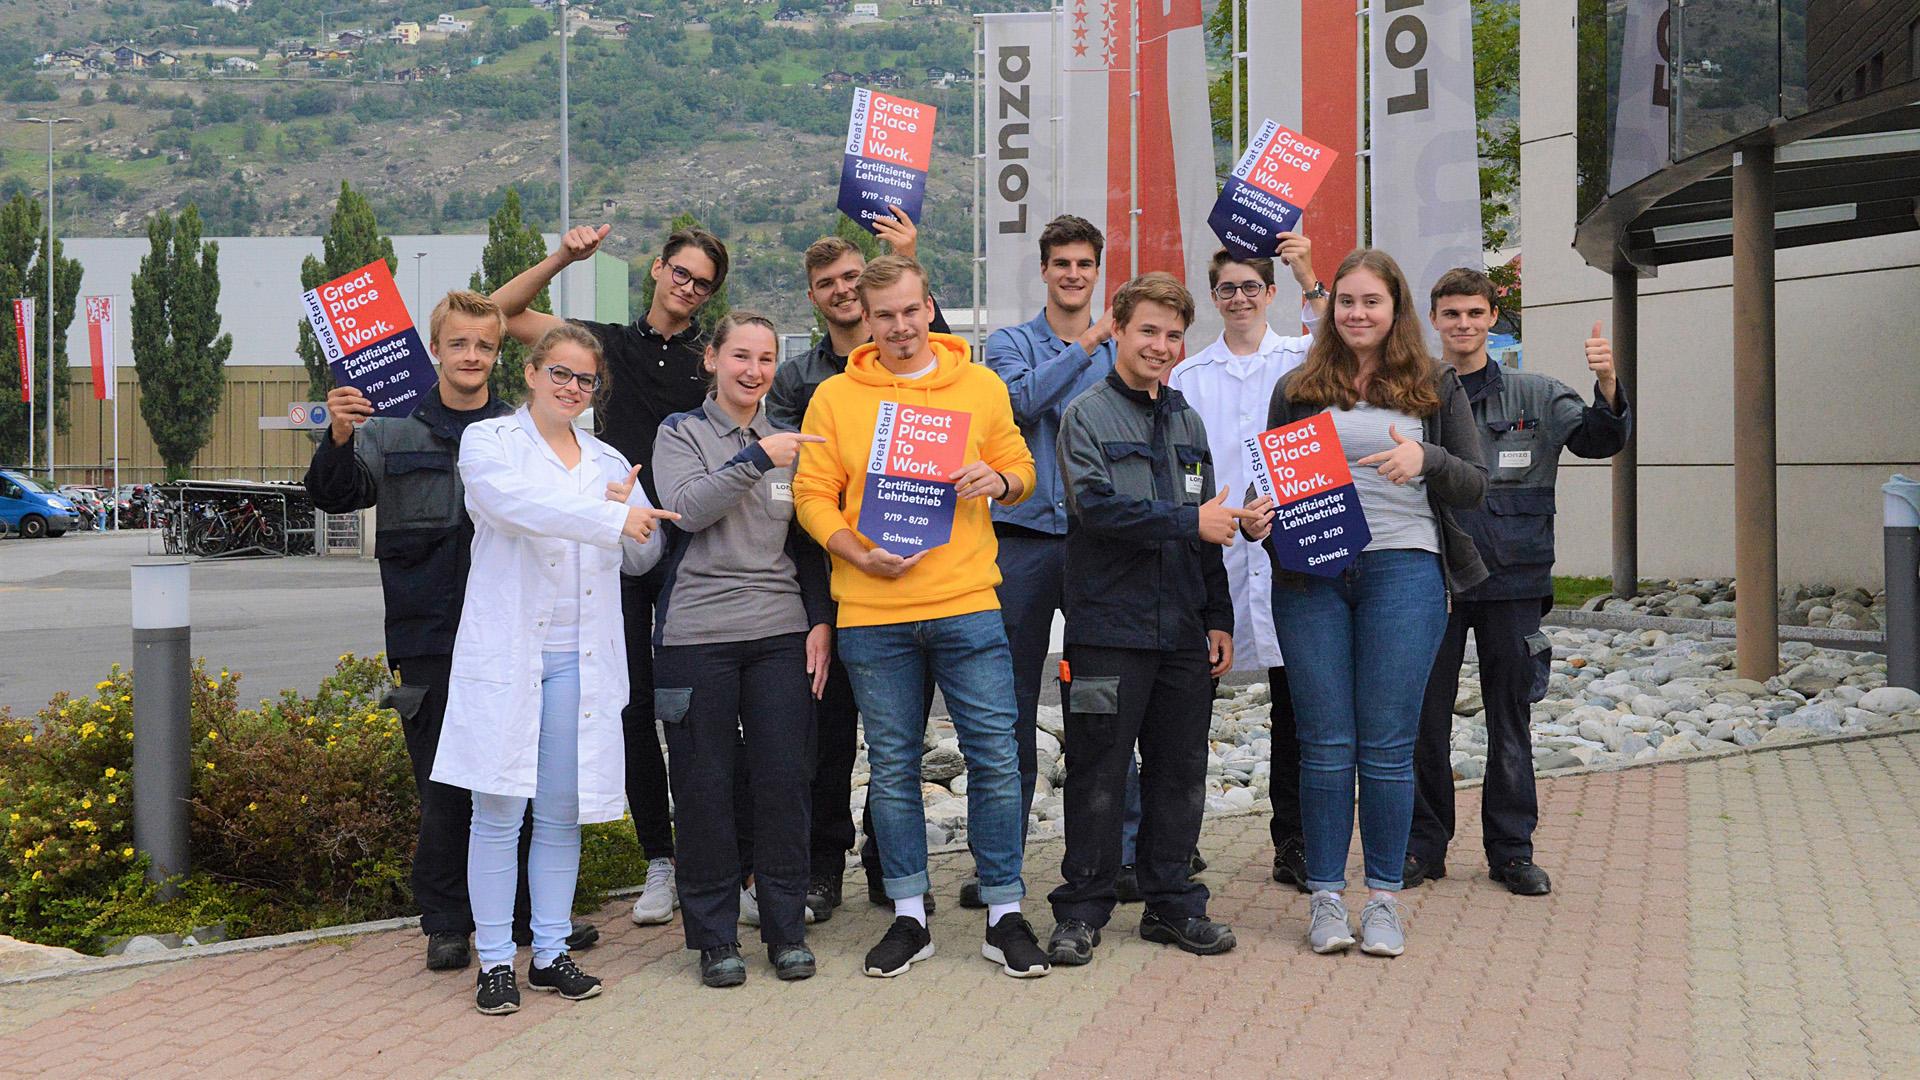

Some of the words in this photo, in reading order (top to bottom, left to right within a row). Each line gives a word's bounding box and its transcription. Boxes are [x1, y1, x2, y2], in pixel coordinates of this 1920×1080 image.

[855, 90, 868, 120] Start!
[874, 97, 920, 119] Great
[870, 126, 887, 140] To
[872, 112, 917, 132] Place
[850, 122, 862, 152] Great
[998, 46, 1030, 234] Lonza
[1237, 150, 1258, 176] Great
[1255, 121, 1276, 148] Start!
[1277, 132, 1320, 160] Great
[855, 160, 916, 180] Zertifizierter
[1263, 156, 1278, 172] To
[1270, 144, 1311, 172] Place
[856, 170, 912, 190] Lehrbetrieb
[862, 191, 878, 201] 9/19
[884, 195, 902, 205] 8/20
[1232, 192, 1283, 223] Lehrbetrieb
[1236, 183, 1290, 215] Zertifizierter
[1231, 214, 1247, 226] 9/19
[1250, 223, 1267, 236] 8/20
[1226, 232, 1258, 253] Schweiz
[323, 271, 374, 301] Great
[304, 292, 324, 325] Start!
[330, 289, 379, 317] Place
[335, 317, 356, 332] To
[320, 327, 338, 358] Great
[342, 336, 407, 370] Zertifizierter
[348, 348, 410, 379] Lehrbetrieb
[366, 380, 384, 394] 9/19
[390, 370, 410, 384] 8/20
[377, 388, 417, 410] Schweiz
[901, 409, 952, 428] Great
[872, 438, 886, 471] Great
[879, 403, 894, 435] Start!
[898, 424, 948, 443] Place
[1264, 423, 1317, 449] Great
[895, 440, 914, 455] To
[1244, 438, 1263, 471] Start!
[1270, 441, 1321, 466] Place
[1274, 467, 1296, 481] To
[877, 478, 945, 496] Zertifizierter
[878, 490, 941, 507] Lehrbetrieb
[1256, 472, 1274, 502] reat
[1277, 492, 1344, 520] Zertifizierter
[1282, 503, 1346, 530] Lehrbetrieb
[884, 513, 902, 522] 9/19
[909, 516, 929, 525] 8/20
[883, 532, 923, 545] Schweiz
[1299, 533, 1316, 546] 9/19
[1324, 526, 1343, 539] 8/20
[1308, 547, 1348, 566] Schweiz
